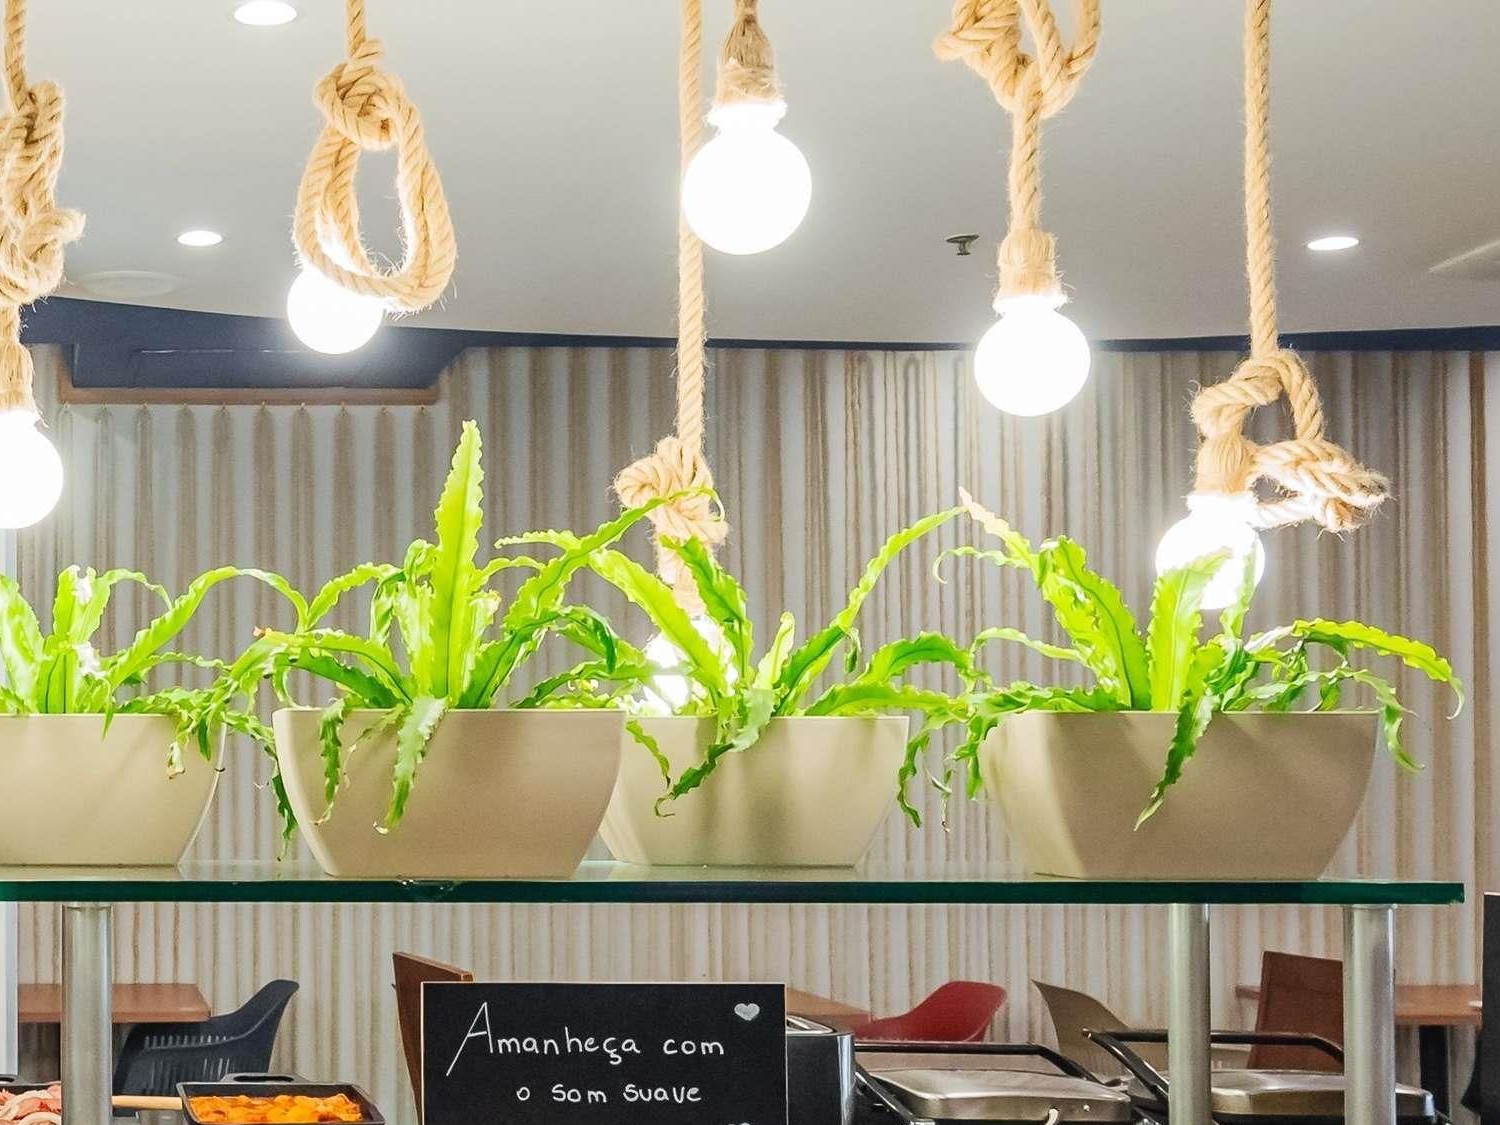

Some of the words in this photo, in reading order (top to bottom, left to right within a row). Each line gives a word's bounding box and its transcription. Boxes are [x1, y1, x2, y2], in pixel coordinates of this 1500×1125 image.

[445, 1001, 641, 1077] Amanheça
[662, 1038, 725, 1056] com
[516, 1086, 532, 1101] o
